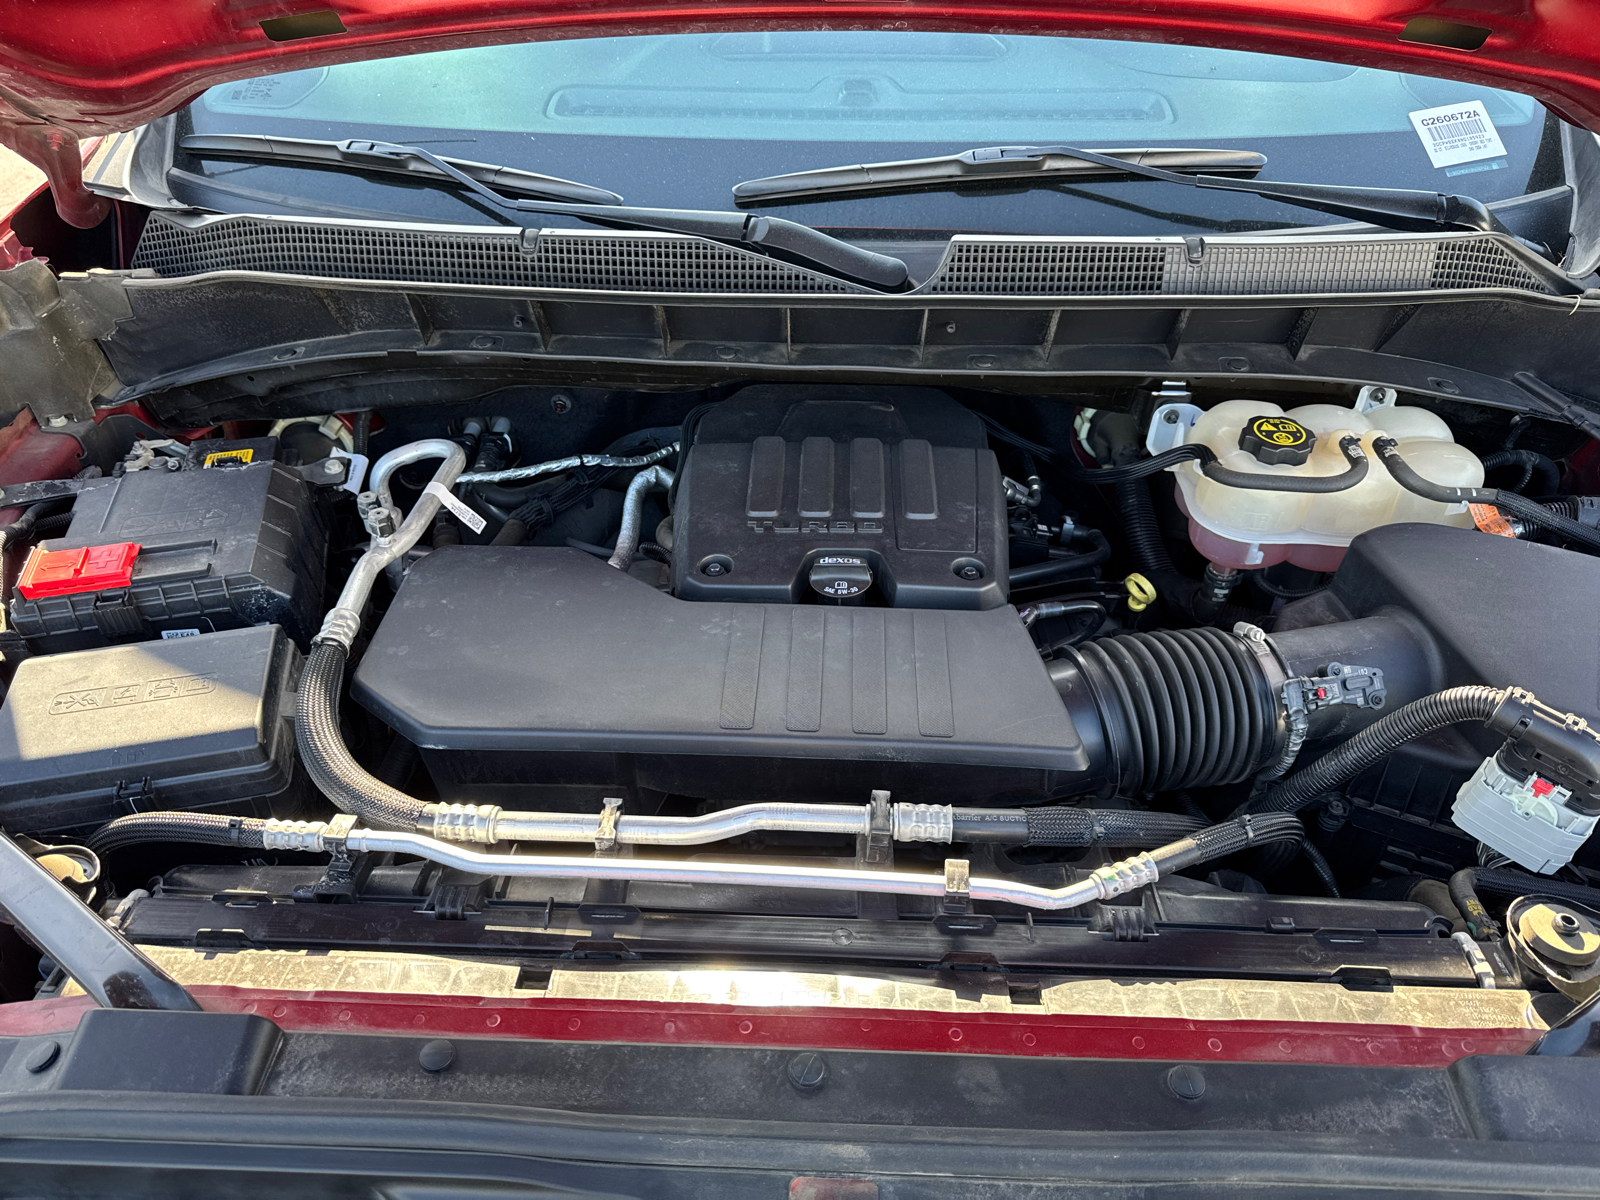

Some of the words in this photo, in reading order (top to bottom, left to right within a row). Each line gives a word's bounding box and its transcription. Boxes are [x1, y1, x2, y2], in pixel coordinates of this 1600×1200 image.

[748, 521, 884, 534] TURBO
[820, 556, 861, 565] dexos
[823, 586, 836, 594] SAE
[837, 586, 859, 595] 5W-30
[878, 994, 919, 1010] FAN
